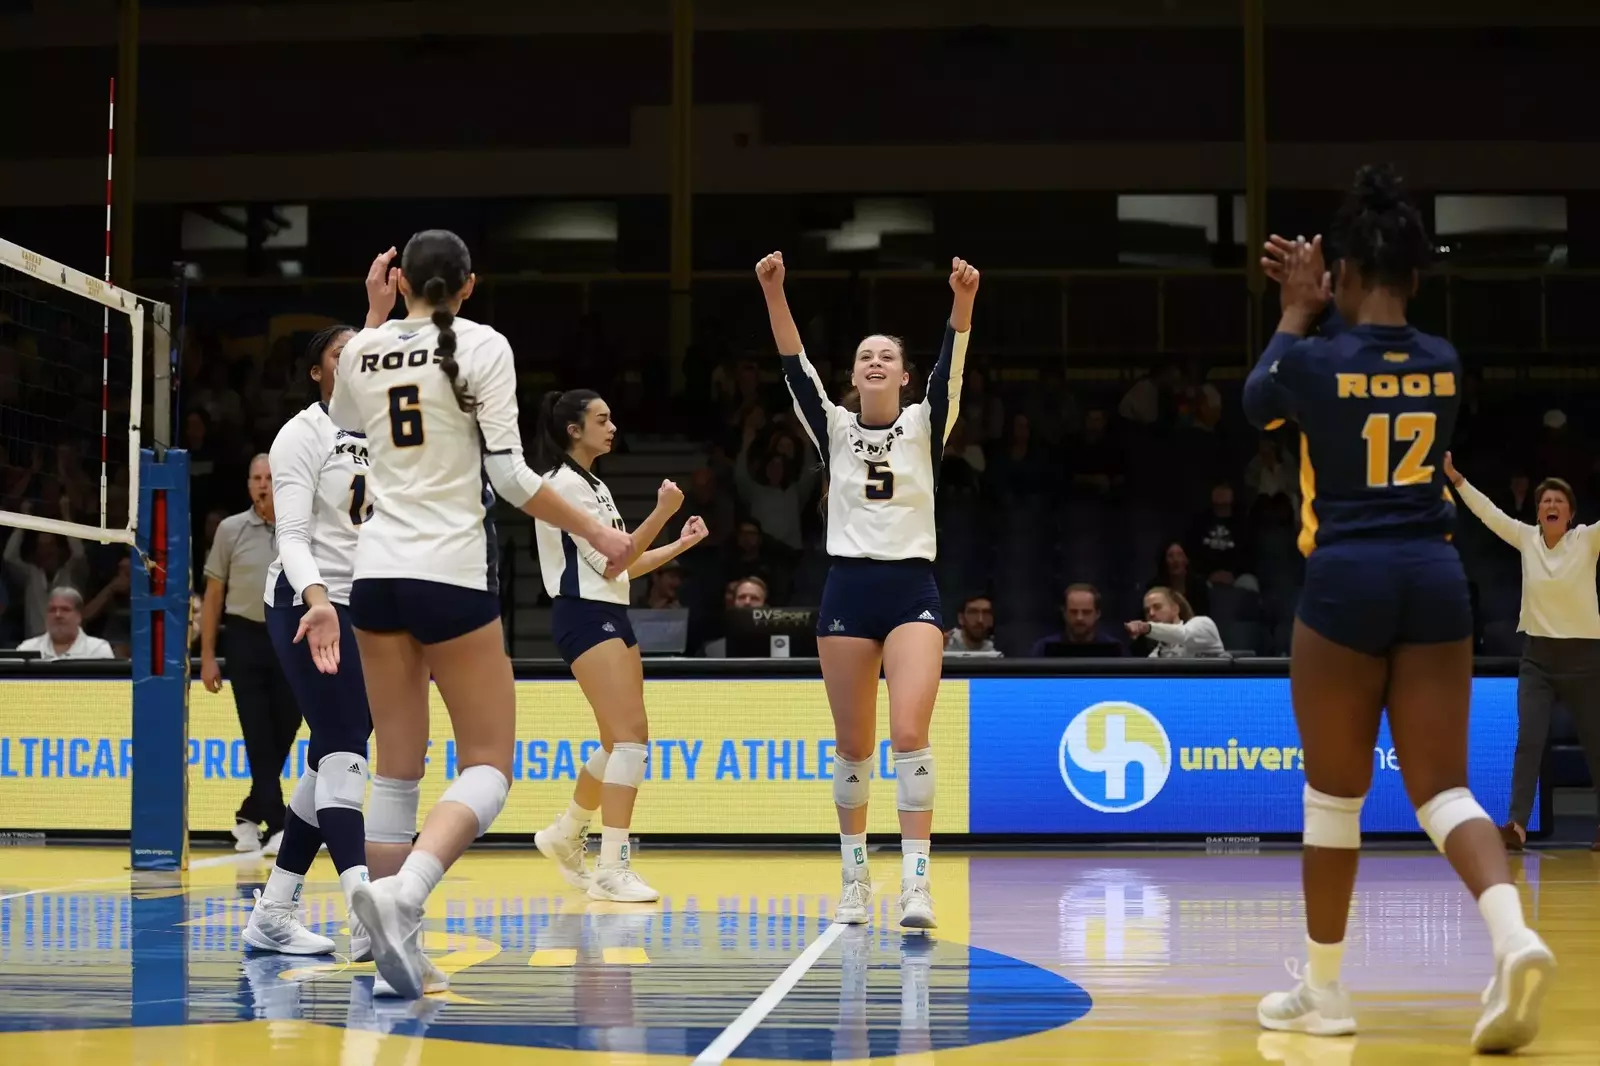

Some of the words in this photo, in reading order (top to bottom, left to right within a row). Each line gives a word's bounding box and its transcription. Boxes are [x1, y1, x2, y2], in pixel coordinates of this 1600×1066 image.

[1335, 371, 1456, 398] ROOS
[388, 383, 425, 448] 6
[1361, 411, 1437, 487] 12
[863, 458, 894, 501] 5
